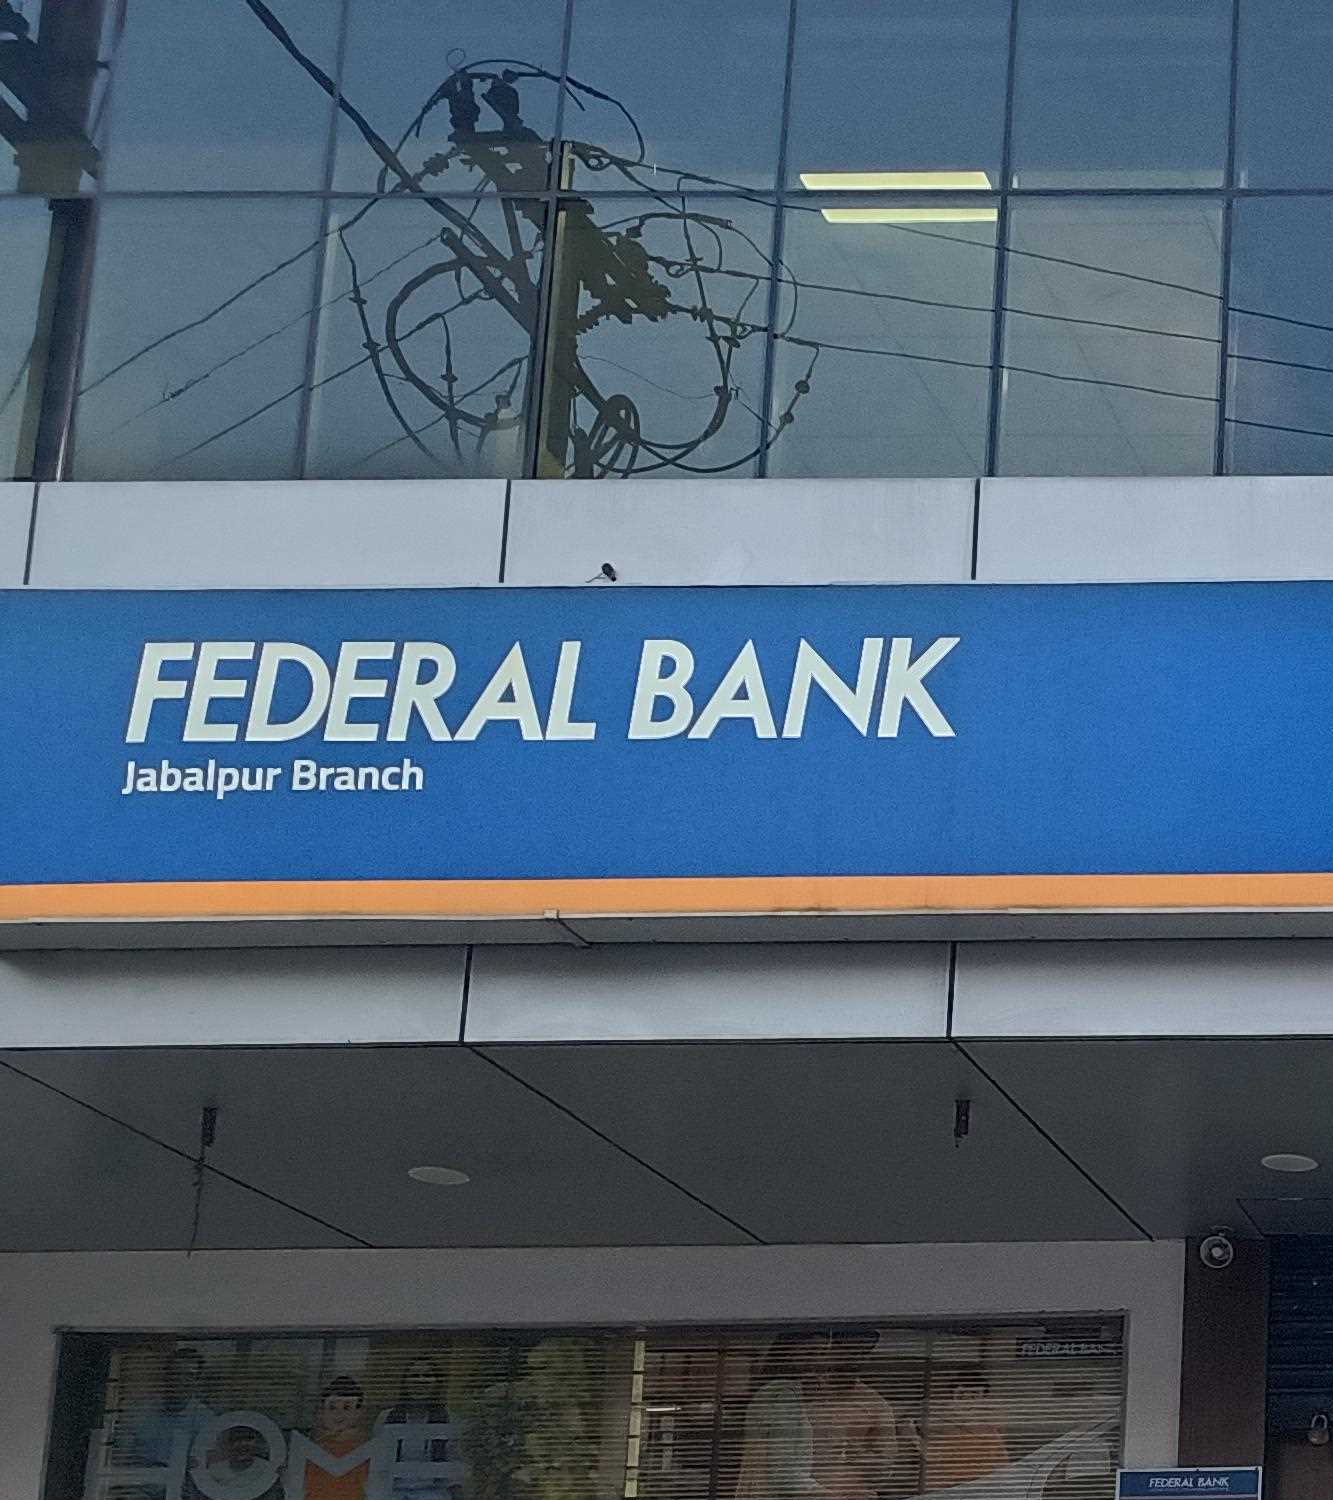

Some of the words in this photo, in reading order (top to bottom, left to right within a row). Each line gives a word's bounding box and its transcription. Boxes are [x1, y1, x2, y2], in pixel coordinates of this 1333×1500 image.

[124, 639, 597, 744] FEDERAL
[627, 636, 960, 740] BANK
[122, 759, 281, 799] Jabalpur
[291, 758, 424, 792] Branch
[1148, 1477, 1194, 1488] FEDERAL
[1197, 1476, 1230, 1488] BANK
